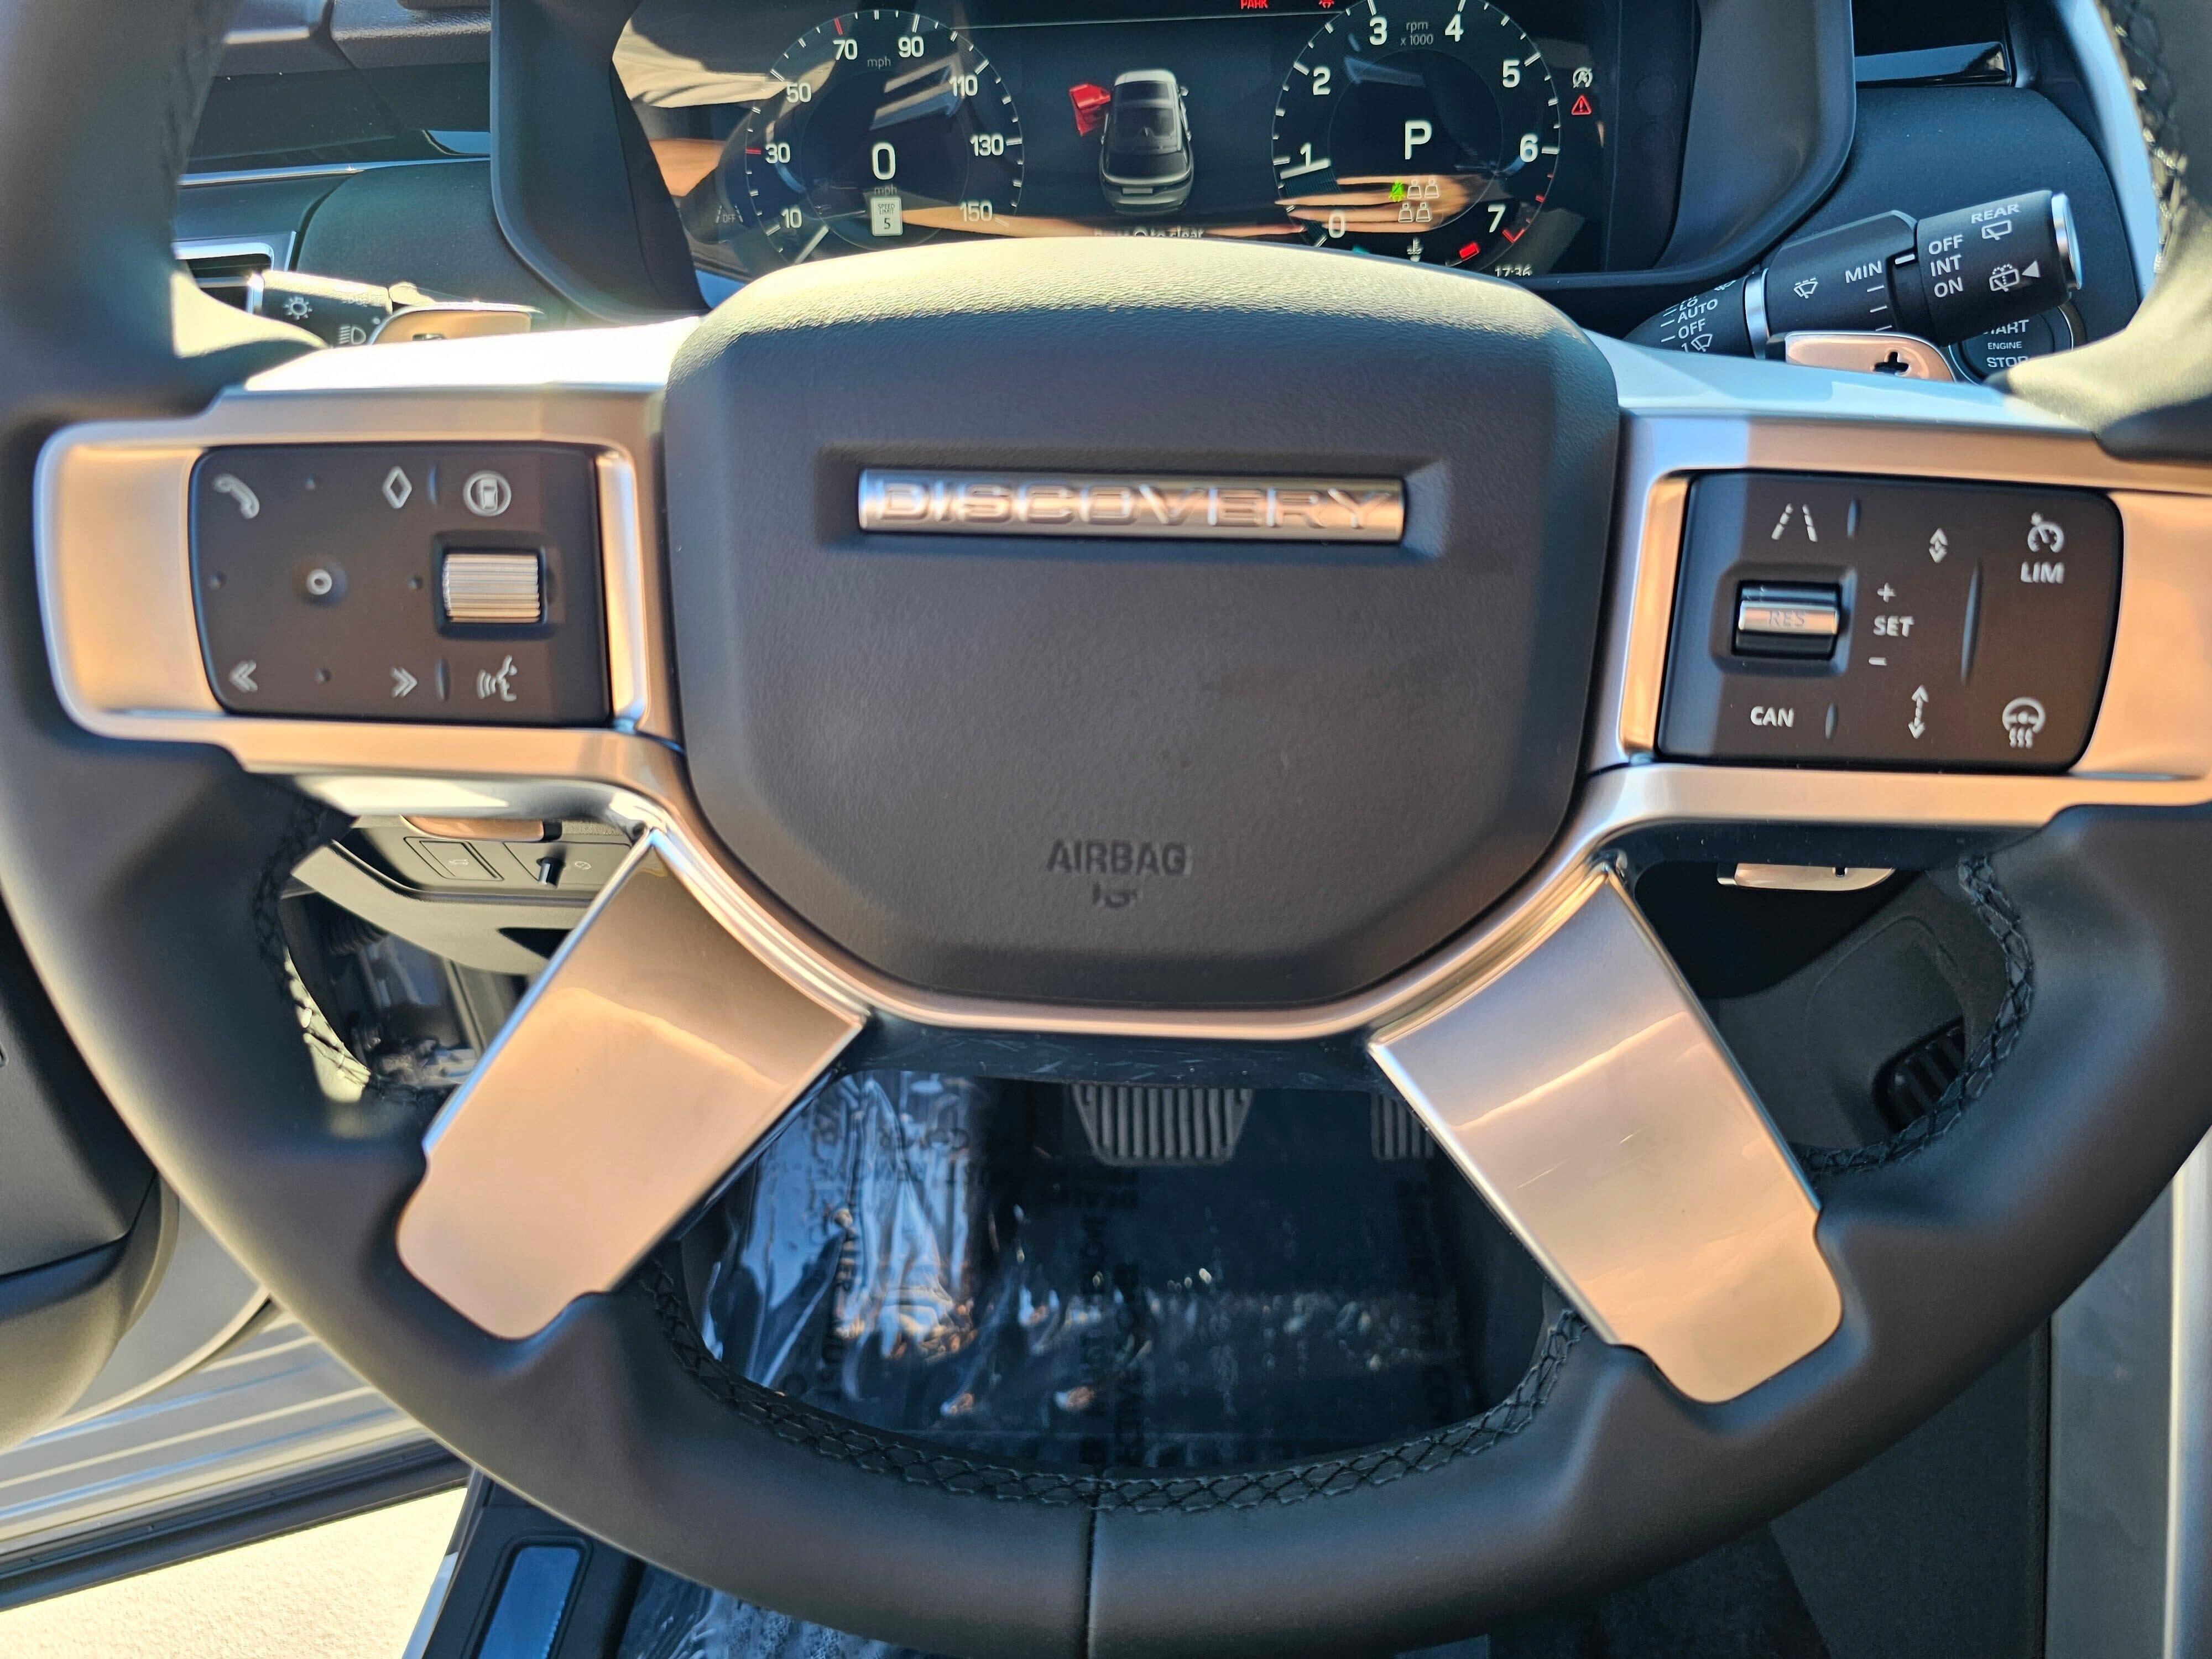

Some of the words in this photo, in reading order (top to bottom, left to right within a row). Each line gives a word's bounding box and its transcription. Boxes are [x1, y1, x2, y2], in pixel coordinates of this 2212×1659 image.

[1369, 17, 1387, 45] 3
[1406, 20, 1428, 32] rpm
[1444, 14, 1464, 42] 4
[833, 39, 858, 60] 70
[898, 36, 925, 58] 90
[1410, 33, 1434, 45] 1000
[867, 56, 891, 70] mph
[1502, 60, 1520, 88] 5
[949, 75, 979, 97] 110
[1312, 66, 1331, 96] 2
[786, 83, 812, 103] 50
[969, 134, 1004, 157] 130
[1404, 120, 1432, 160] P
[1520, 134, 1538, 163] 6
[765, 142, 791, 164] 30
[872, 142, 896, 180] 0
[1300, 143, 1312, 166] 1
[874, 184, 898, 196] mph
[722, 213, 736, 222] OFF
[780, 207, 803, 229] 10
[959, 201, 993, 222] 150
[1488, 204, 1506, 233] 7
[1970, 204, 2020, 224] REAR
[884, 217, 891, 229] 5
[1328, 212, 1346, 238] 0
[1928, 234, 1964, 255] OFF
[1844, 260, 1883, 284] MIN
[1930, 254, 1962, 277] INT
[1933, 276, 1964, 298] ON
[1677, 299, 1718, 324] AUTO
[1677, 318, 1705, 339] OFF
[1983, 319, 2030, 335] ART
[1987, 341, 2023, 350] ENGINE
[877, 479, 1391, 529] DISCOVERY
[2020, 562, 2064, 583] LIM
[1768, 609, 1807, 628] RES
[1872, 615, 1914, 637] SET
[1750, 706, 1794, 728] CAN
[1046, 838, 1187, 877] AIRBAG
